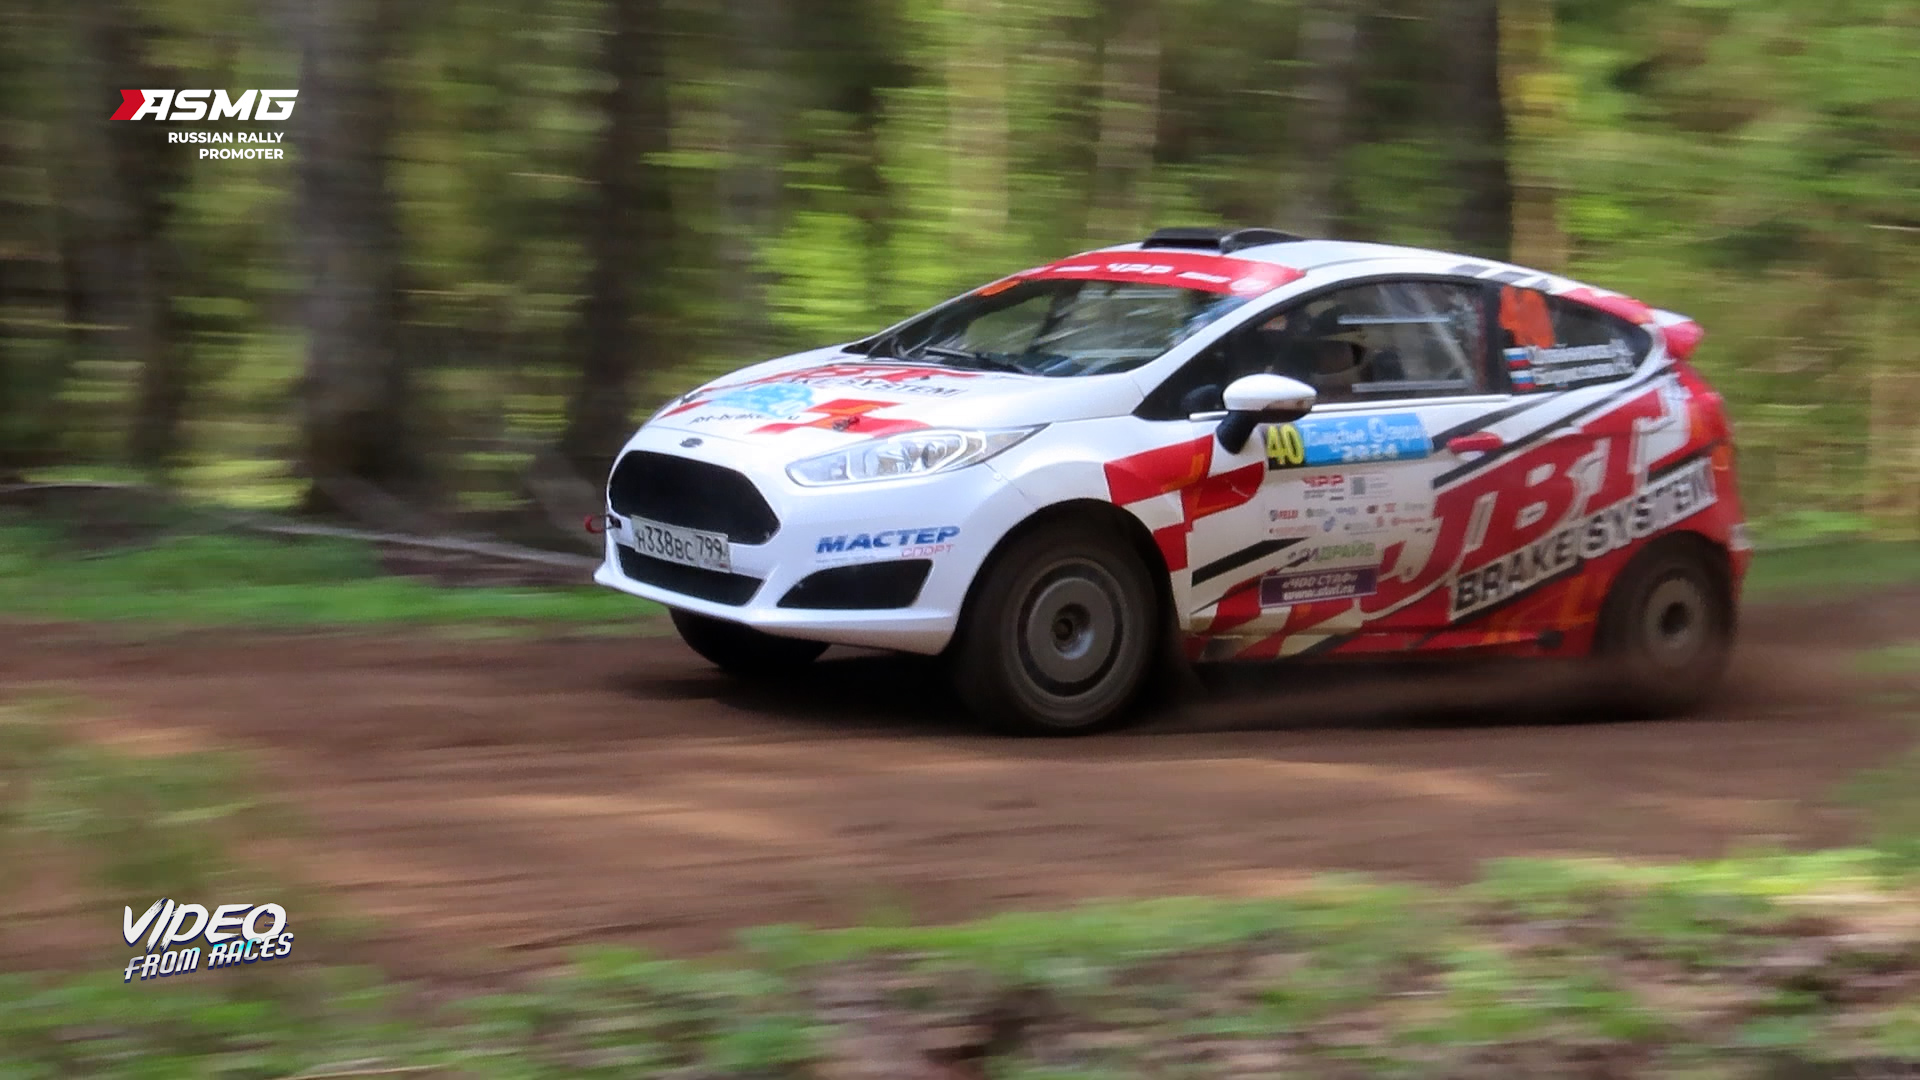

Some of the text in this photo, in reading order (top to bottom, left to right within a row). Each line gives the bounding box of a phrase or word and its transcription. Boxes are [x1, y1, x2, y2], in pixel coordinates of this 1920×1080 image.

[1266, 424, 1304, 465] 40
[695, 534, 727, 559] 799
[816, 525, 961, 554] МАСТЕР
[1454, 468, 1712, 612] BRAKE SYSTEM
